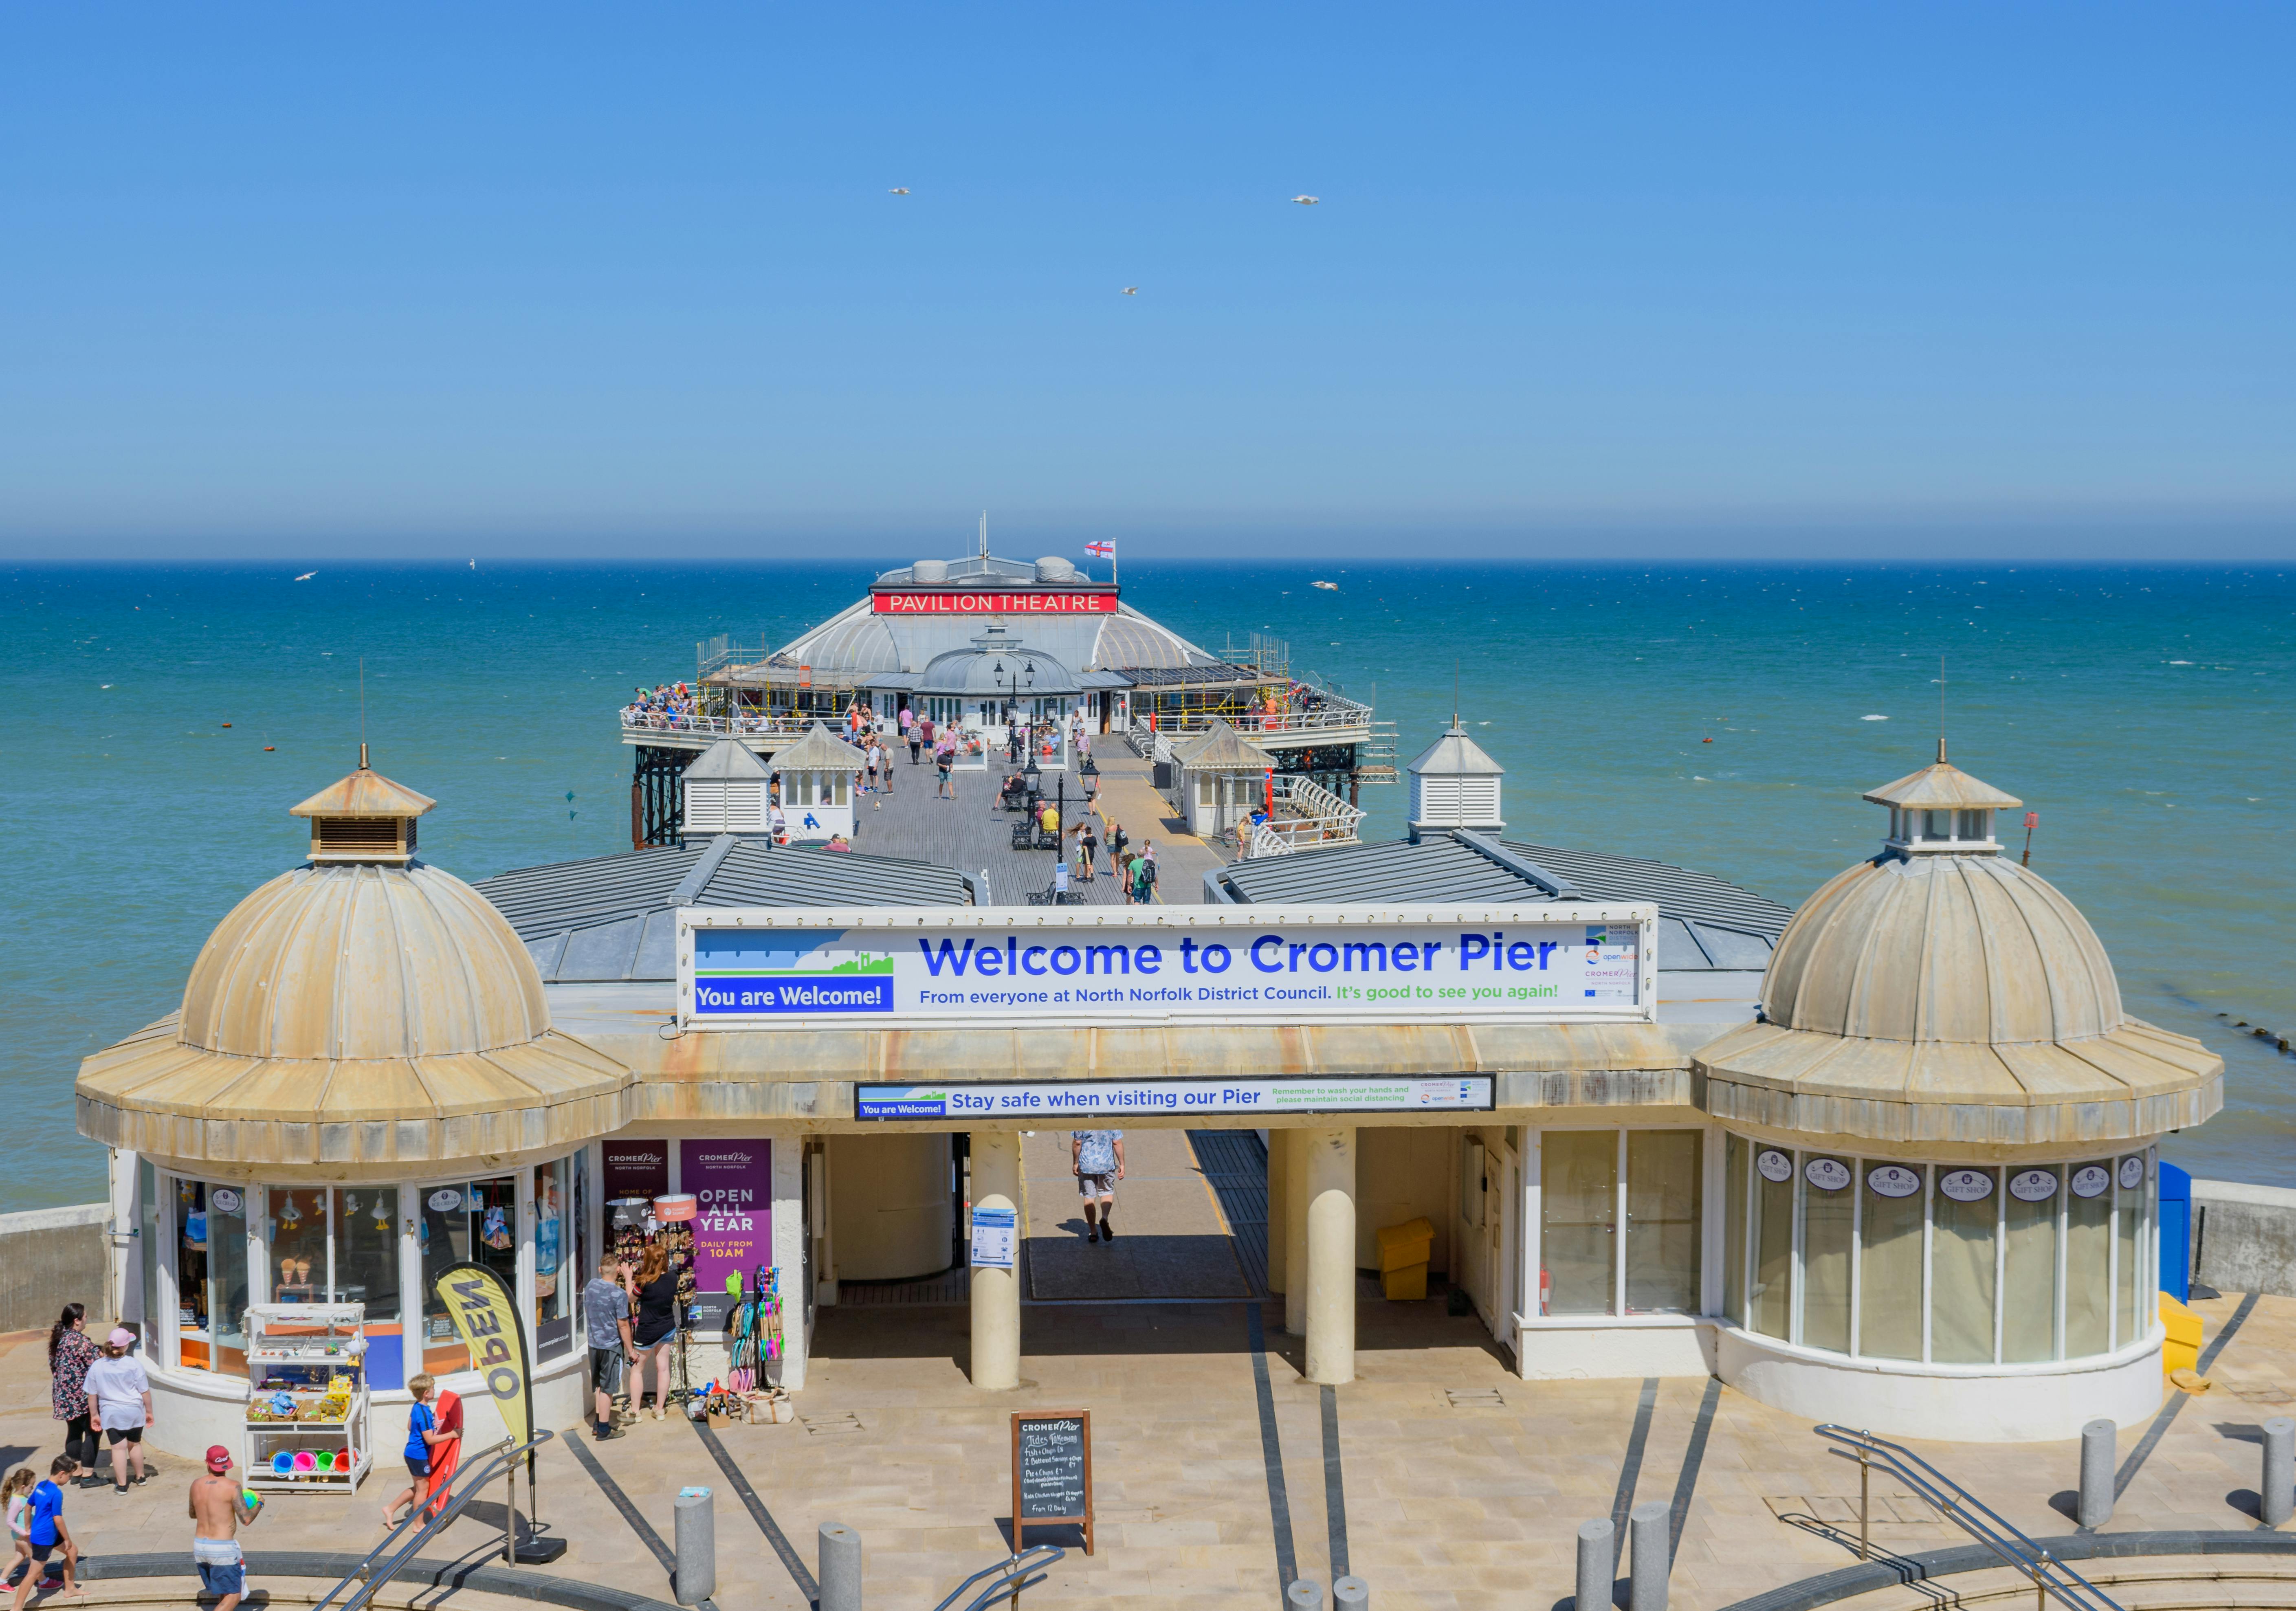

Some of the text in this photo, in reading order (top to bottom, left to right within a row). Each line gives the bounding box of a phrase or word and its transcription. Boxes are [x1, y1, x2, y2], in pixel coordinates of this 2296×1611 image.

[891, 595, 1100, 610] PAVILION THEATRE
[919, 932, 1557, 976] Welcome to Cromer Pier
[1603, 953, 1638, 962] openwide
[697, 986, 880, 1006] You are Welcome!
[920, 991, 964, 1003] From
[970, 992, 1048, 1005] everyone
[1054, 990, 1069, 1002] at
[1076, 989, 1123, 1001] North
[1130, 988, 1192, 1001] Norfolk
[1199, 987, 1258, 1000] District
[1265, 986, 1331, 999] Council.
[1366, 987, 1410, 1001] good
[1416, 986, 1433, 998] to
[1438, 988, 1467, 998] see
[1472, 987, 1502, 1001] you
[1507, 985, 1557, 1000] again!
[952, 1088, 1260, 1110] Stay safe when visiting our Pier
[863, 1106, 880, 1114] You
[898, 1104, 941, 1113] Welcome!
[1761, 1164, 1788, 1176] GIFT SHOP
[1827, 1176, 1845, 1184] SHOP
[699, 1189, 752, 1202] OPEN
[708, 1204, 745, 1217] ALL
[700, 1218, 753, 1231] YEAR
[710, 1248, 743, 1258] 10AM
[451, 1279, 520, 1400] OPEN
[1027, 1435, 1048, 1445] Tides
[1025, 1457, 1029, 1466] 2
